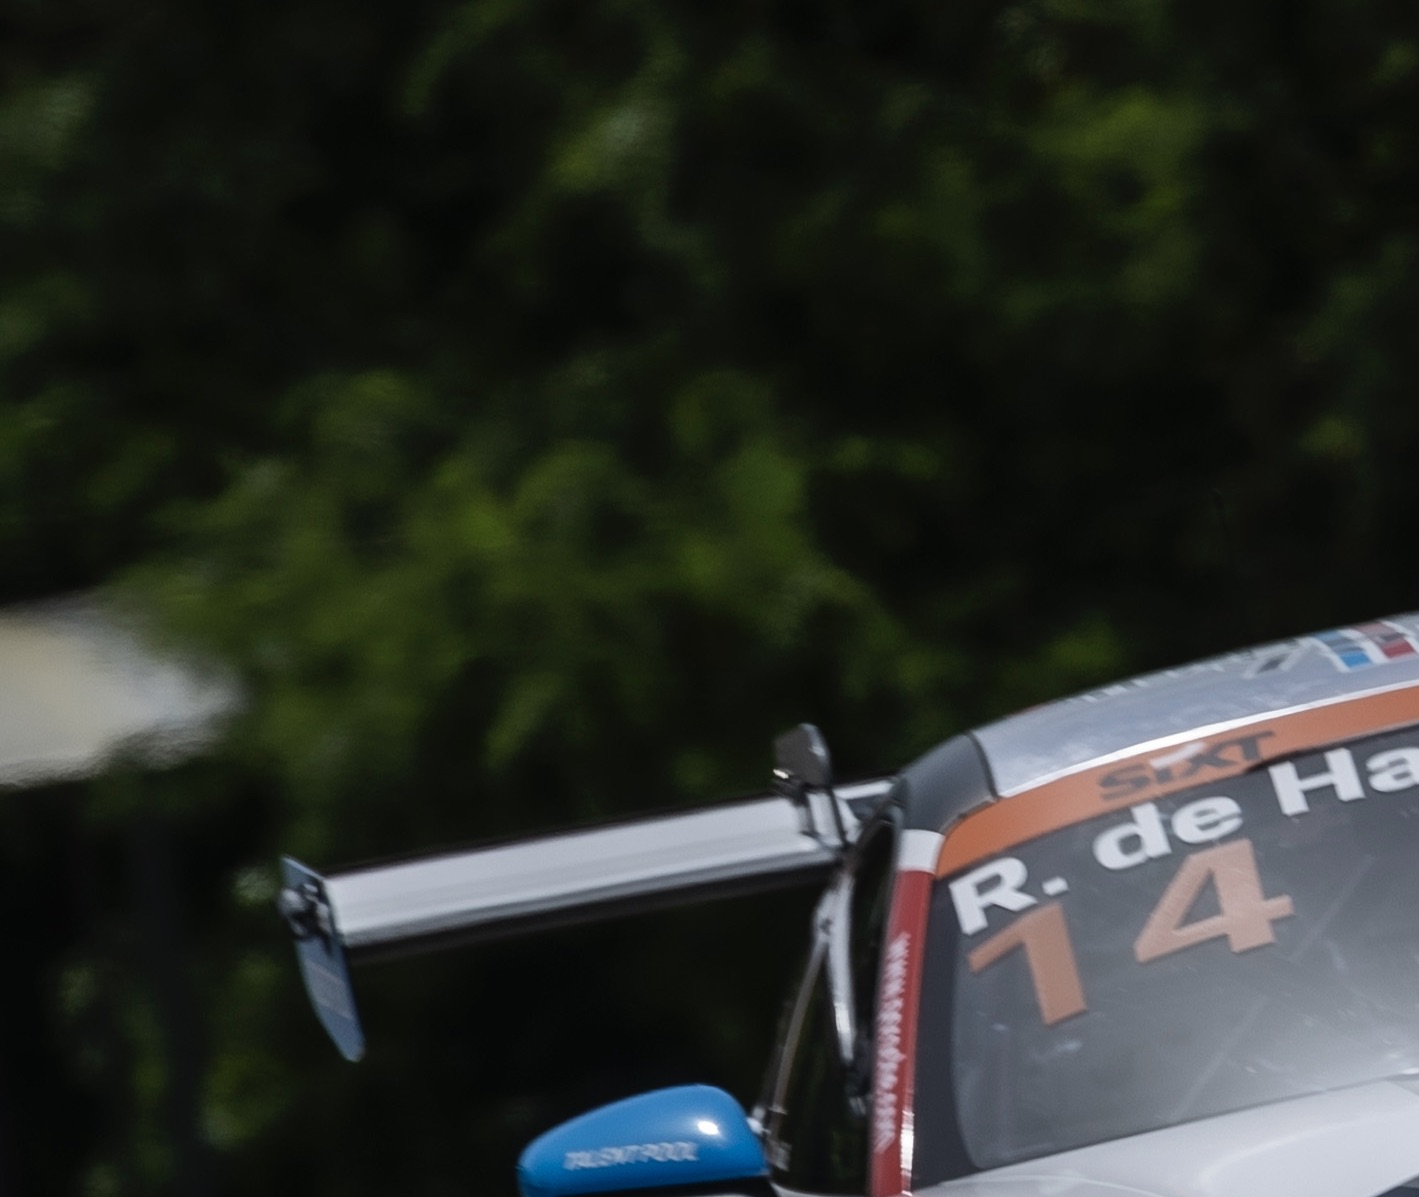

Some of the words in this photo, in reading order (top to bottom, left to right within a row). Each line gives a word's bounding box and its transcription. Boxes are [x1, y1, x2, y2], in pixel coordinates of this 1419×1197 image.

[949, 857, 1069, 935] R.
[1092, 796, 1244, 869] de
[968, 838, 1295, 1026] 14
